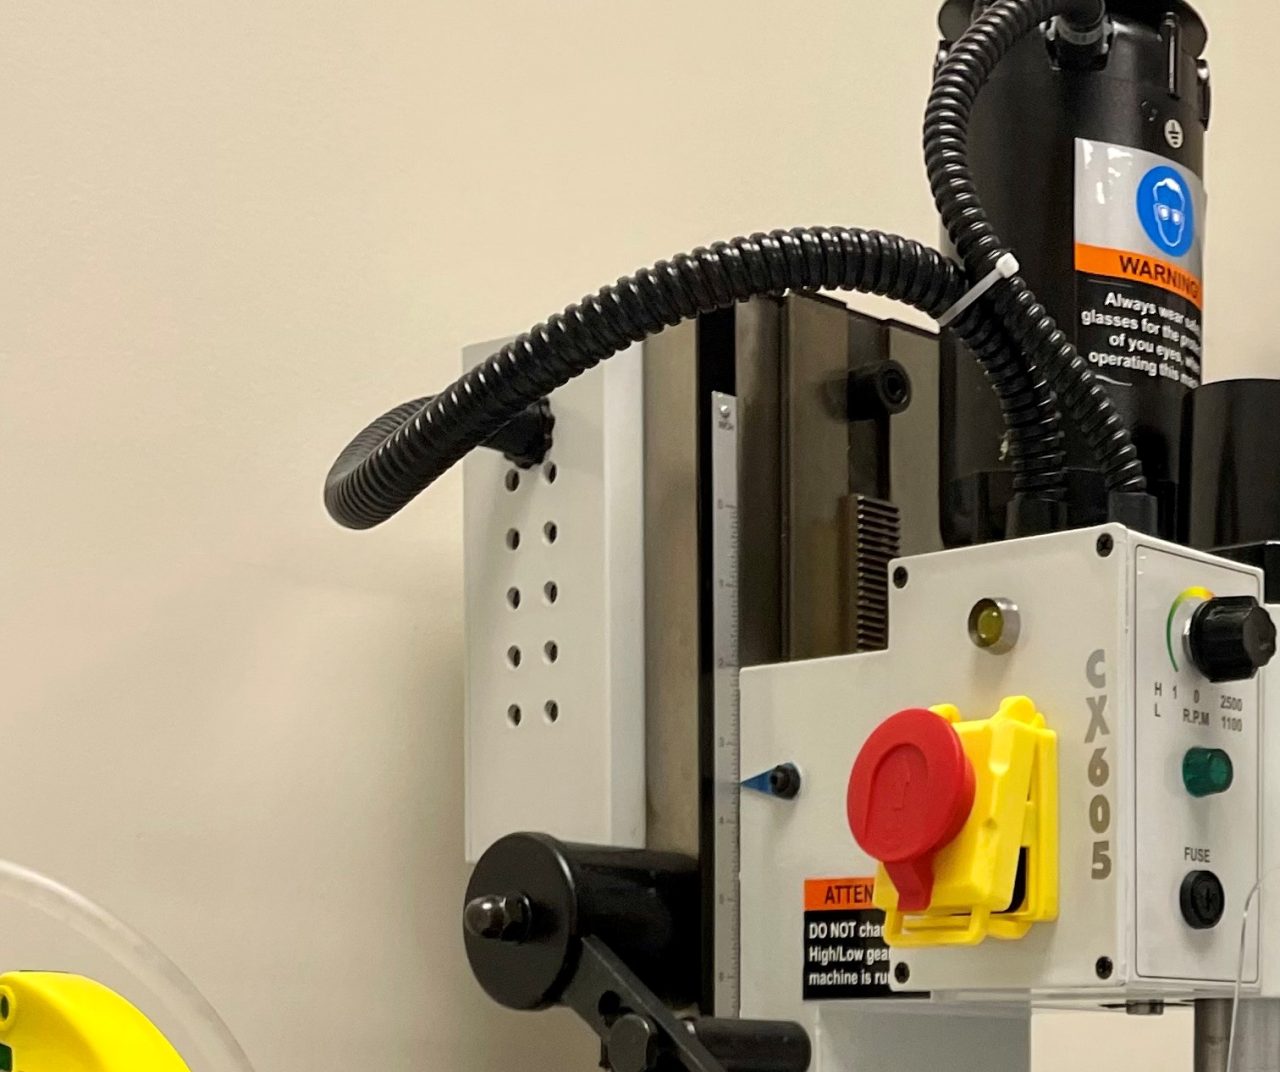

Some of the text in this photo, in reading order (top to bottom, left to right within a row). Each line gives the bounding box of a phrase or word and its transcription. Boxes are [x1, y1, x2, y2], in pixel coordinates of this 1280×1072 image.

[1119, 255, 1198, 299] WARNING
[1104, 292, 1156, 315] Always
[1081, 309, 1138, 329] glasses
[1141, 318, 1160, 335] for
[1162, 325, 1179, 342] the
[1109, 333, 1126, 347] of
[1127, 338, 1154, 353] you
[1088, 352, 1157, 376] operating
[1159, 363, 1179, 380] this
[1154, 682, 1243, 712] H 1 0 2500
[1154, 703, 1161, 717] L
[1221, 716, 1243, 732] 1100
[1084, 648, 1112, 881] CX605
[1184, 847, 1211, 863] FUSE
[824, 884, 875, 904] ATTEN
[809, 920, 884, 939] DO NOT cha
[808, 945, 864, 966] High/Low
[808, 968, 858, 985] machine
[861, 968, 872, 984] is
